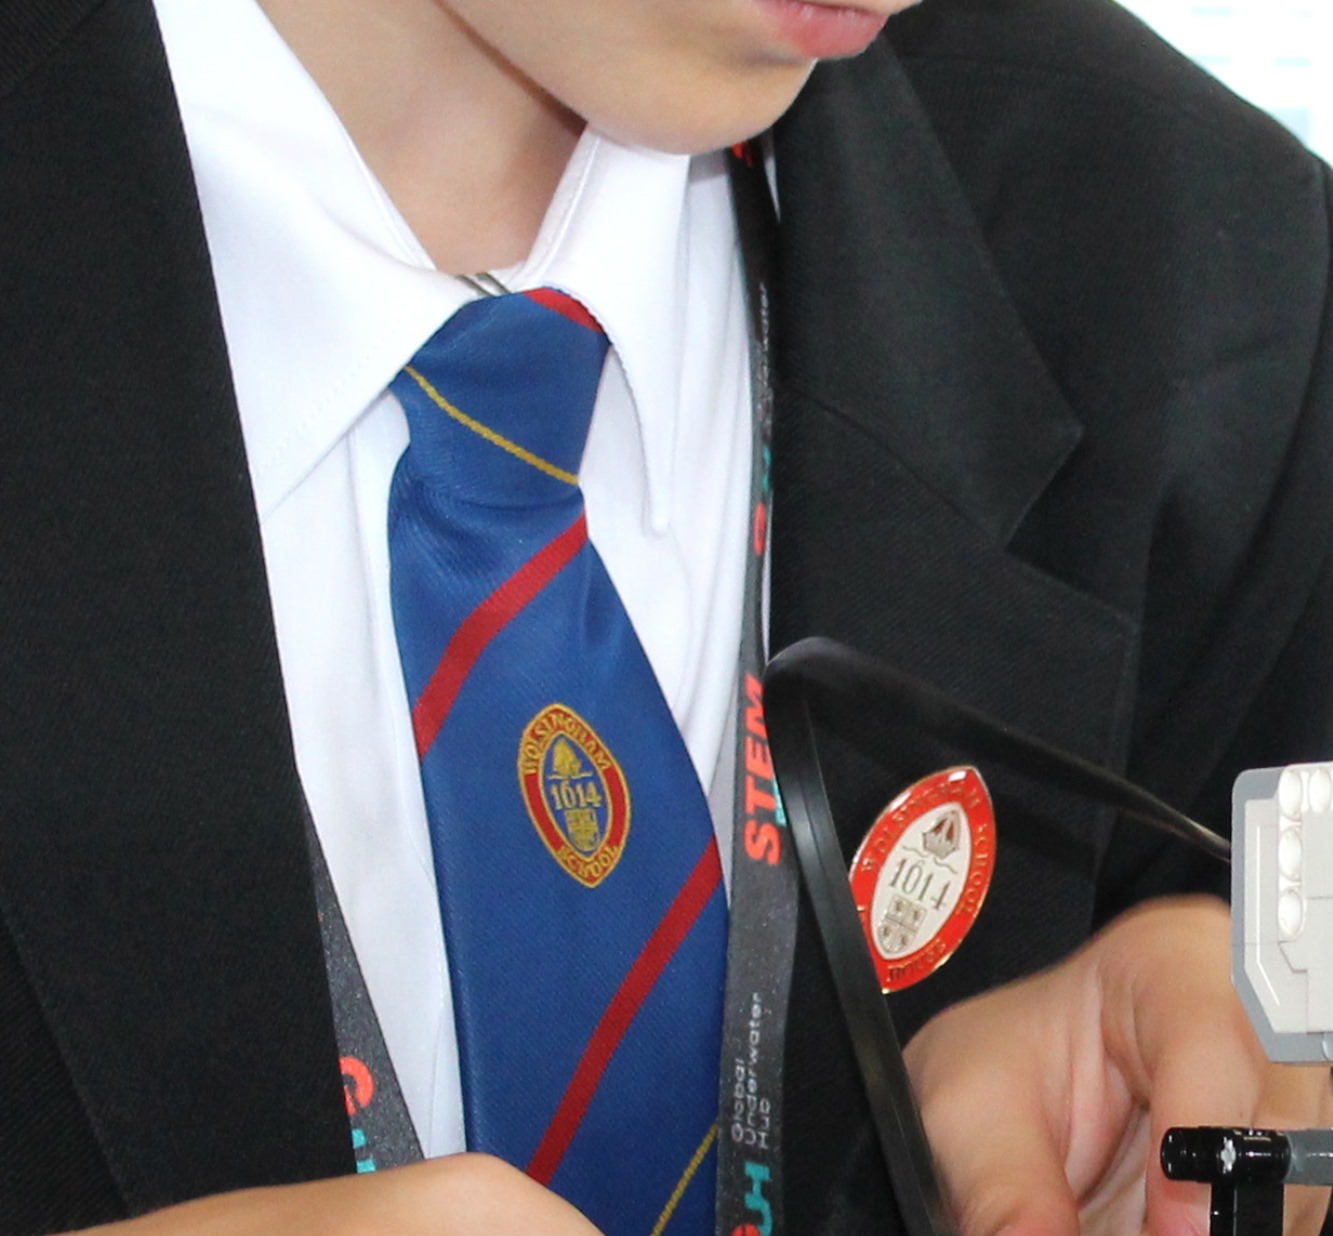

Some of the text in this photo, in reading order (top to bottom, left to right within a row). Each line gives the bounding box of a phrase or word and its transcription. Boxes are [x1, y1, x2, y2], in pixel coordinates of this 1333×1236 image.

[551, 779, 602, 810] 1614
[744, 672, 782, 866] STEM
[730, 1057, 746, 1143] Global
[743, 991, 764, 1146] Underwater
[757, 1097, 771, 1150] Hub
